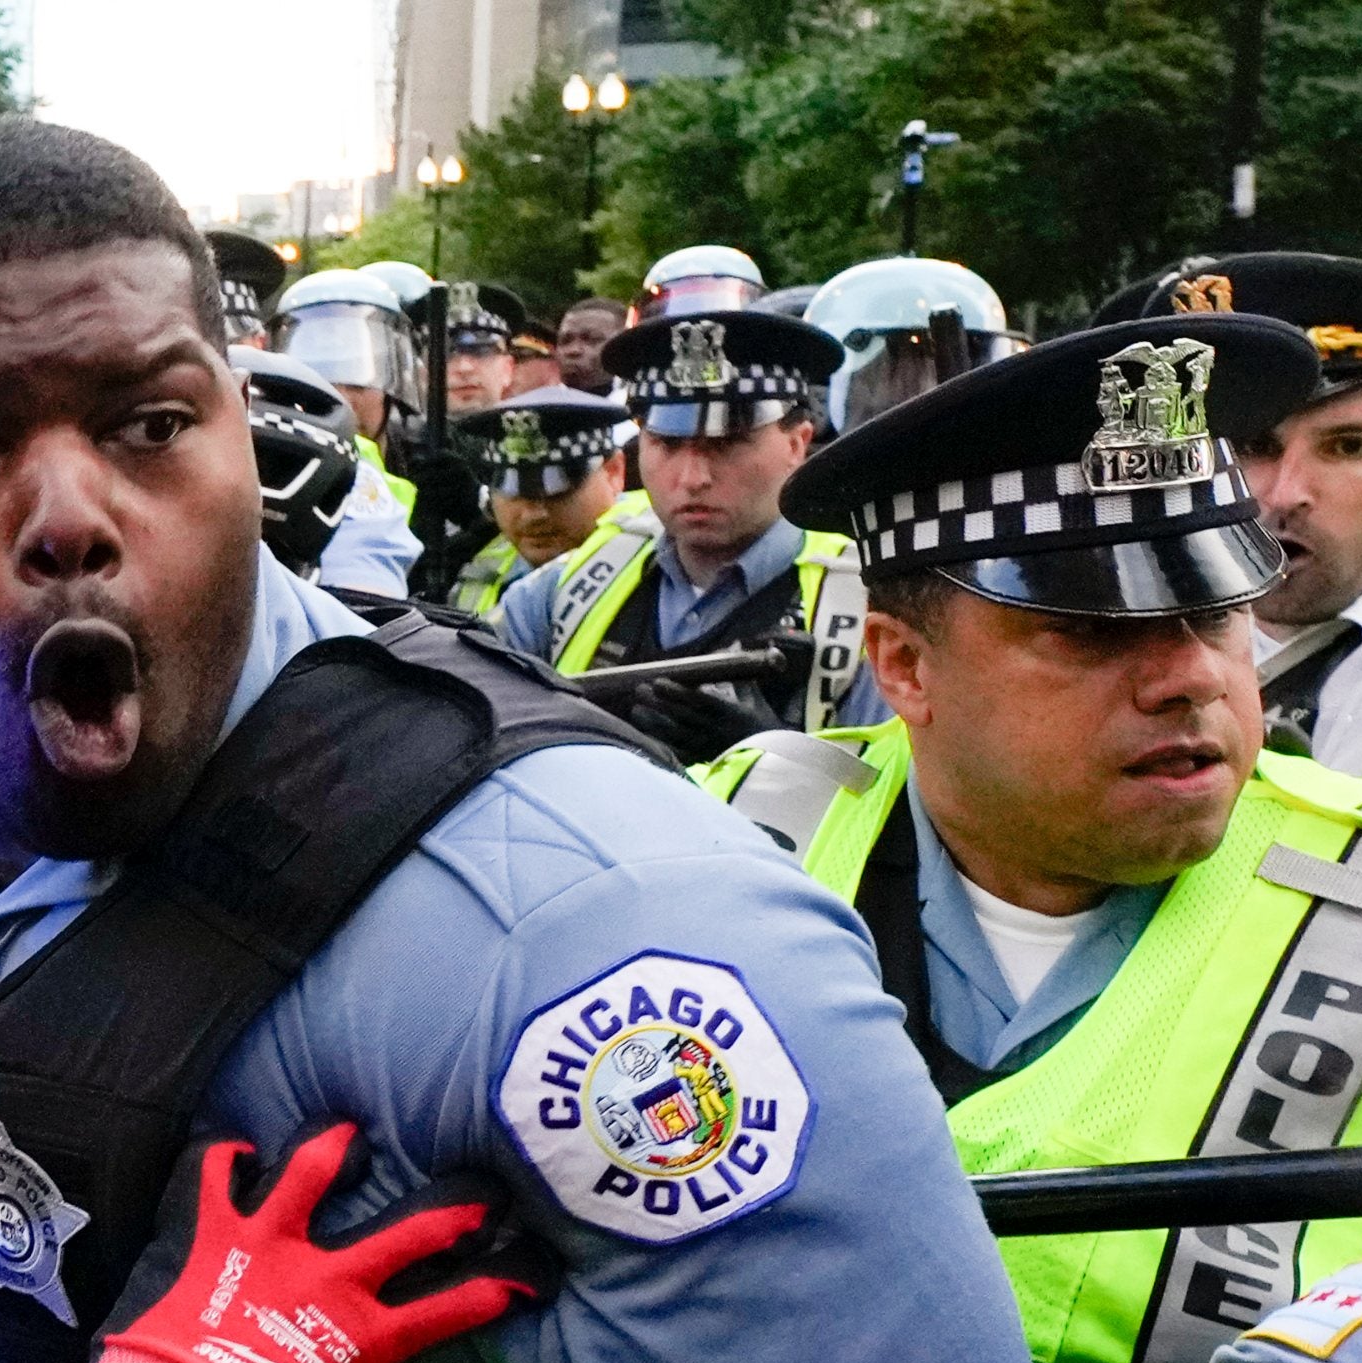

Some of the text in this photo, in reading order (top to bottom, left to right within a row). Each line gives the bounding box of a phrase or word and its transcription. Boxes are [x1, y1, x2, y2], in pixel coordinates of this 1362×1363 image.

[539, 986, 743, 1132] CHICAGO
[16, 1177, 58, 1254] POLICE
[594, 1096, 778, 1217] POLICE
